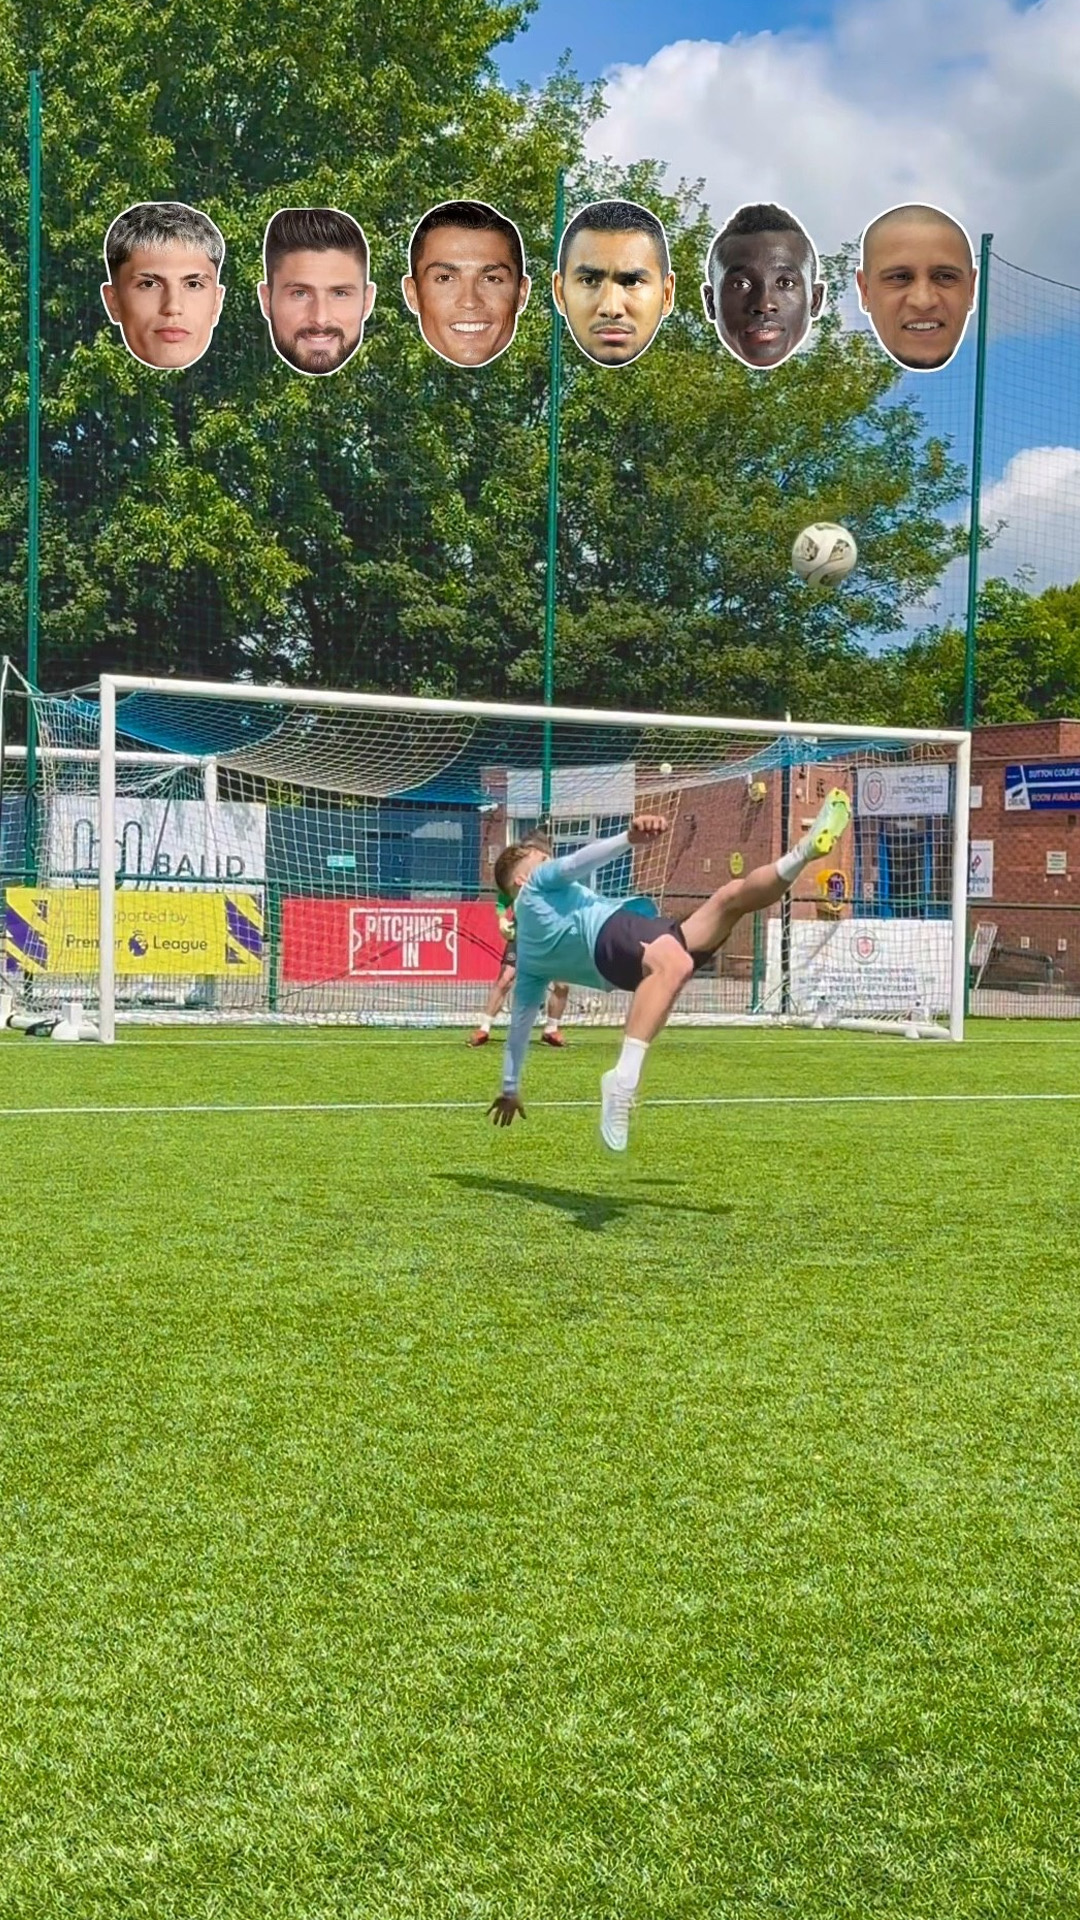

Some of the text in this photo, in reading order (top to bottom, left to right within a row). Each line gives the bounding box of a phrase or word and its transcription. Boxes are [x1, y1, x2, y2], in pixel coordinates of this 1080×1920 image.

[90, 909, 188, 926] Sported by
[365, 915, 443, 942] PITCHING
[153, 935, 208, 953] League
[402, 942, 420, 968] IN
